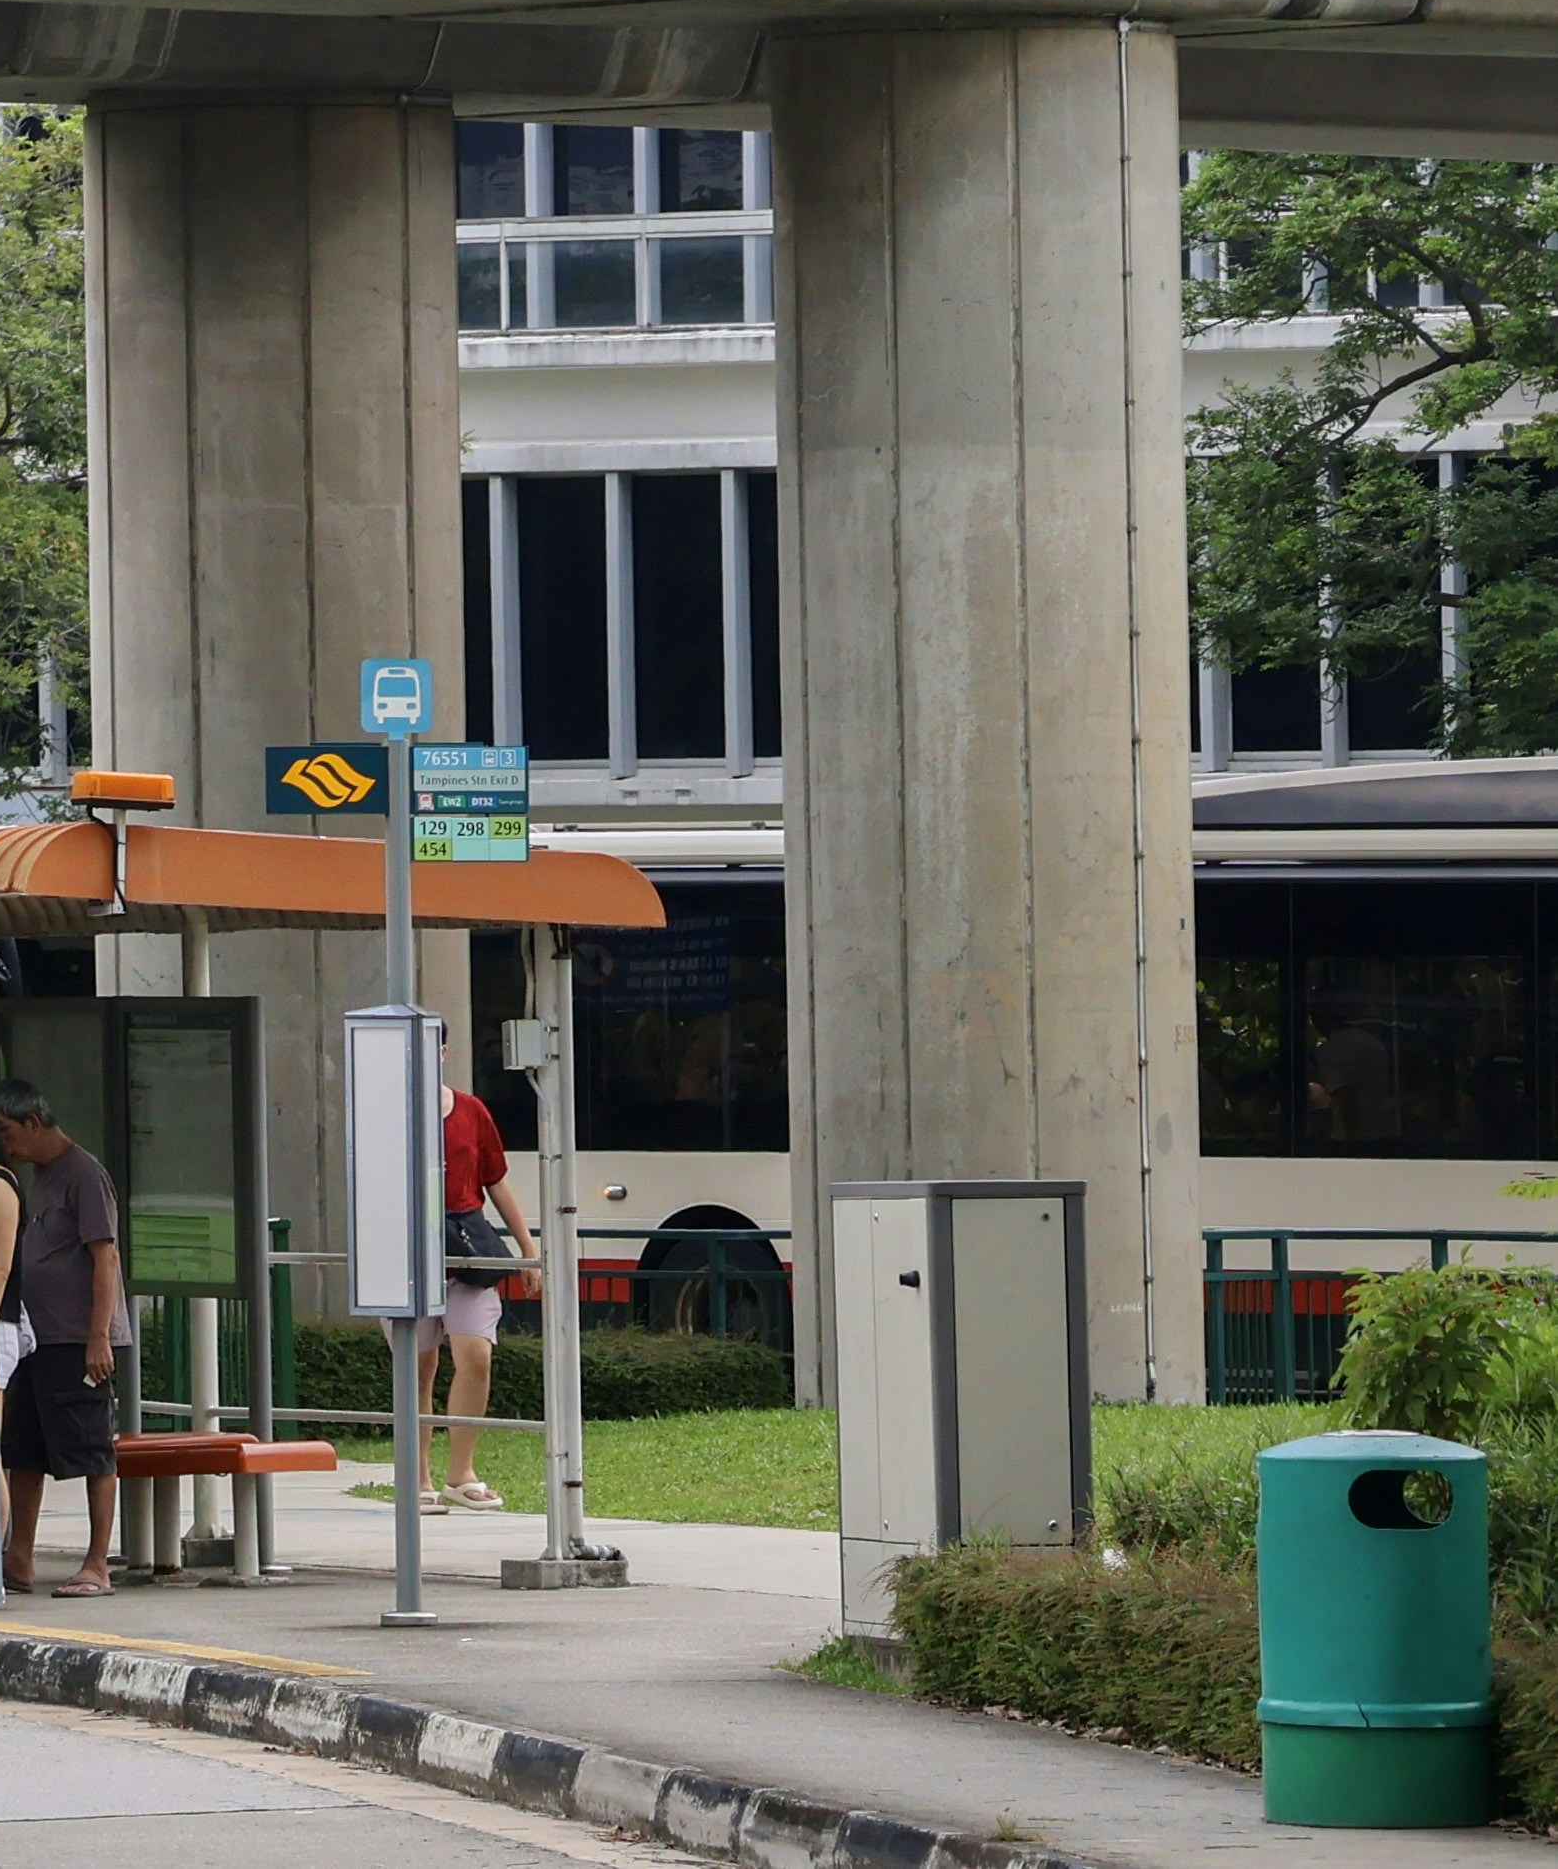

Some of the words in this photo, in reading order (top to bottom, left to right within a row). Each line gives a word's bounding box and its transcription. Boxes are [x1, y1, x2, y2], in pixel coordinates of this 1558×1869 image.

[422, 751, 467, 766] 76551
[505, 751, 514, 765] 3
[420, 775, 468, 787] Tampines
[471, 775, 487, 785] Stn
[490, 775, 508, 785] Exit
[512, 775, 519, 785] D
[471, 796, 494, 806] DT32
[419, 821, 447, 835] 129
[457, 822, 485, 836] 298
[494, 821, 522, 836] 299
[419, 842, 447, 857] 454
